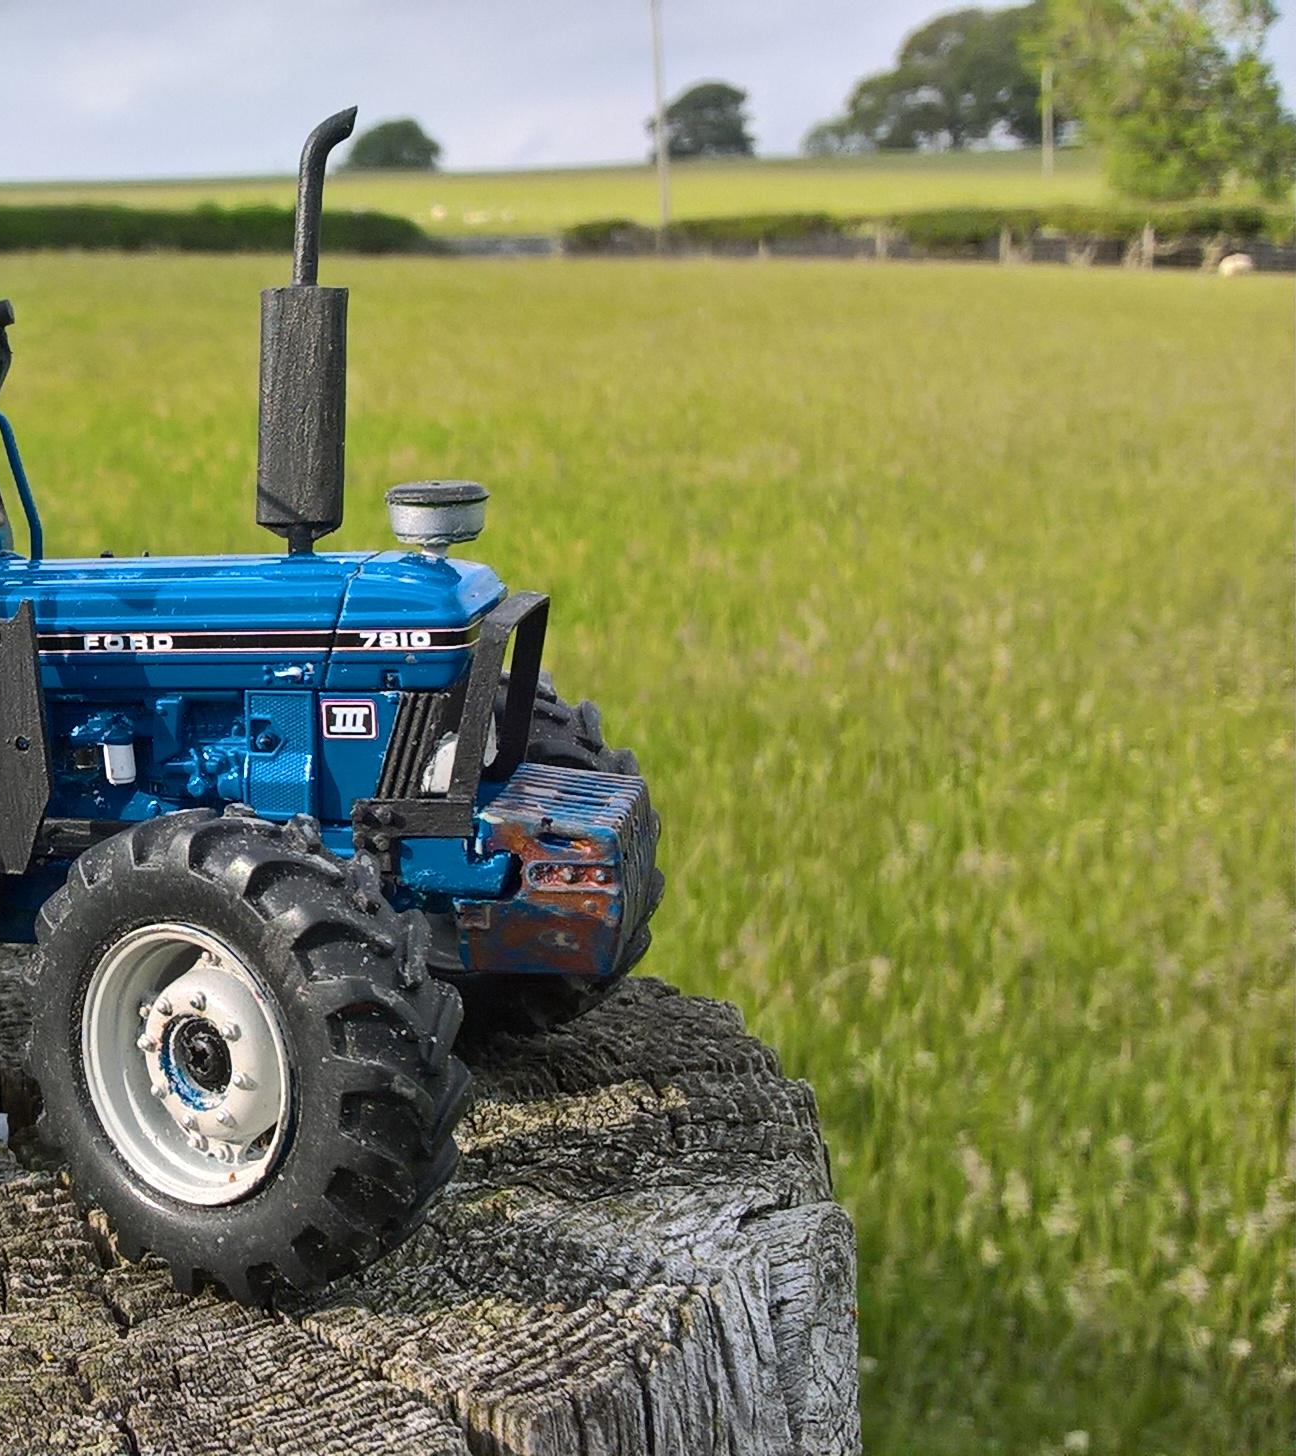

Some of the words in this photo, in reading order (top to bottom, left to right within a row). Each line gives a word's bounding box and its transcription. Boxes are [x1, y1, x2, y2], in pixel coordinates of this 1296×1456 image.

[84, 633, 174, 652] FORD
[359, 631, 431, 649] 7810
[329, 706, 370, 733] III
